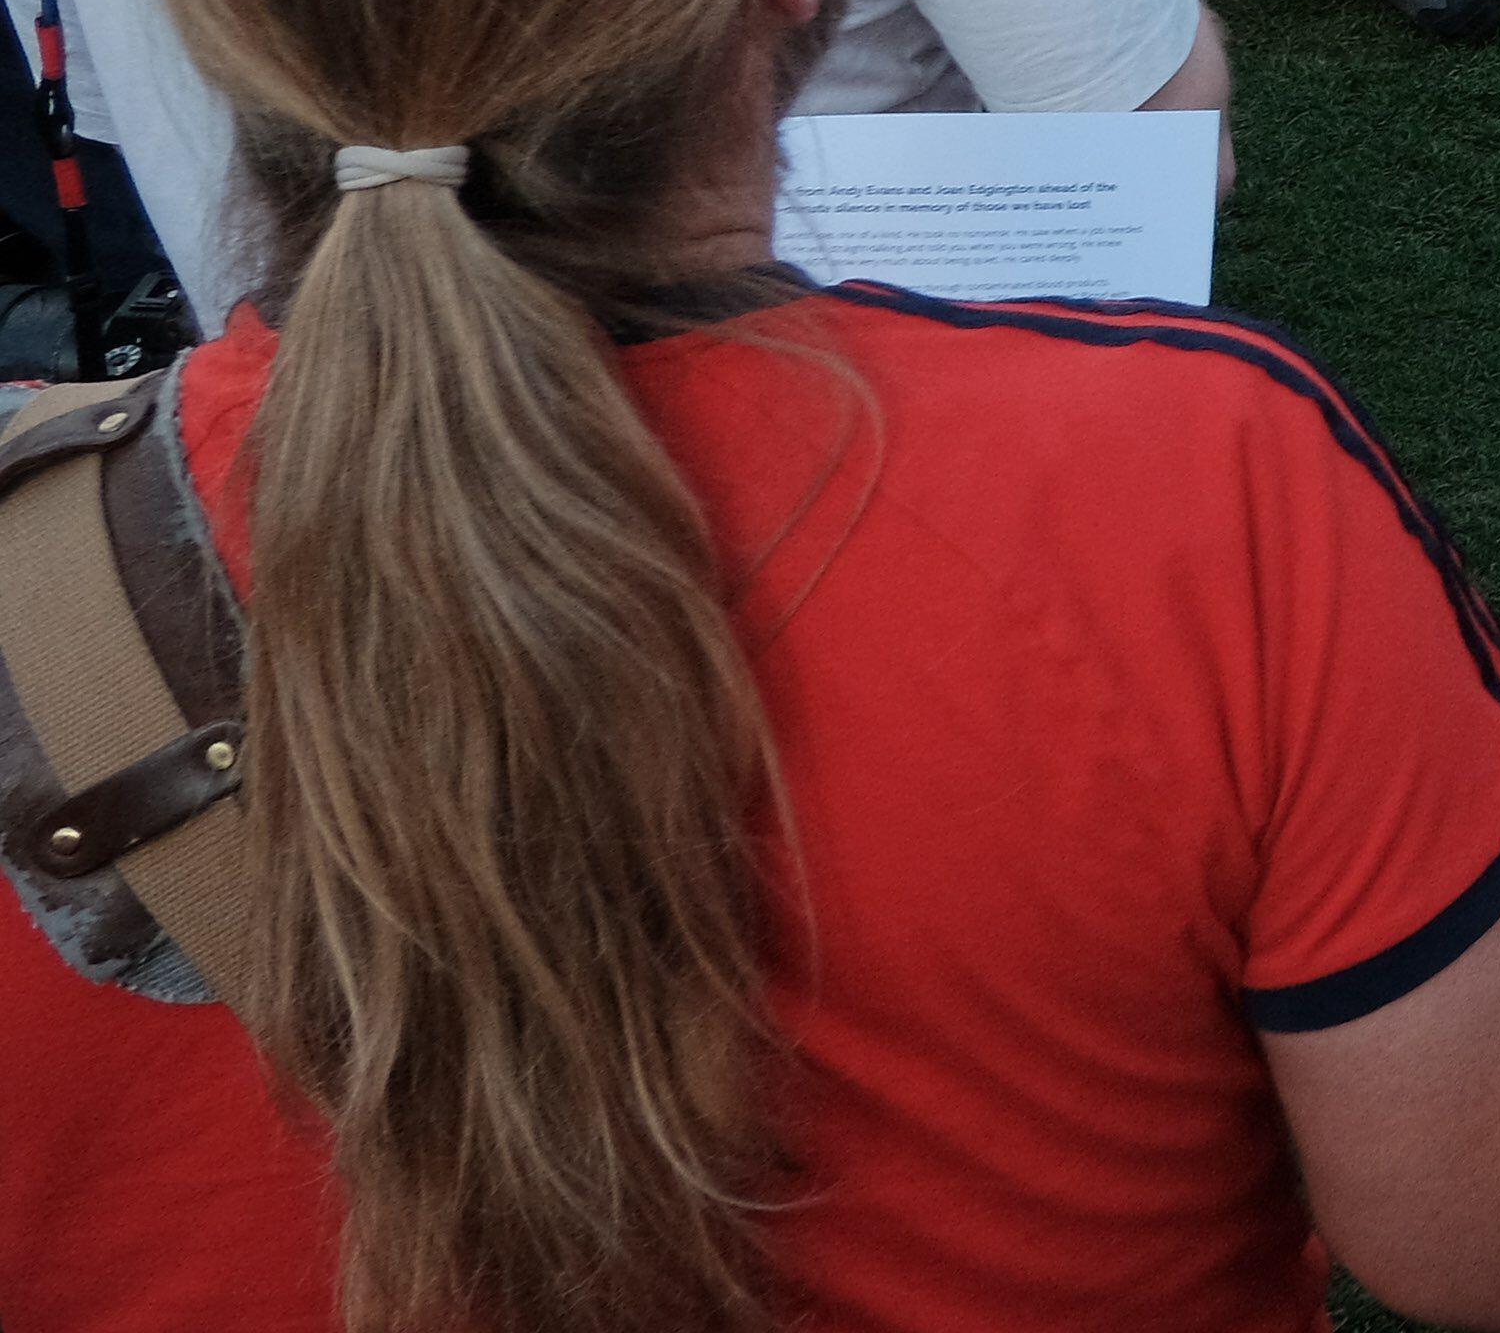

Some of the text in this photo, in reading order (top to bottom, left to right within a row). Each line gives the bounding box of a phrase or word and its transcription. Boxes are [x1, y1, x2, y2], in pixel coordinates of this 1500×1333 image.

[828, 185, 864, 199] Andy
[866, 184, 905, 196] Evans
[907, 184, 932, 196] and
[935, 184, 963, 196] Joan
[1038, 182, 1078, 194] ahead
[1080, 181, 1095, 193] of
[1096, 181, 1119, 193] the
[834, 199, 1092, 216] silence in memory of those we have lost
